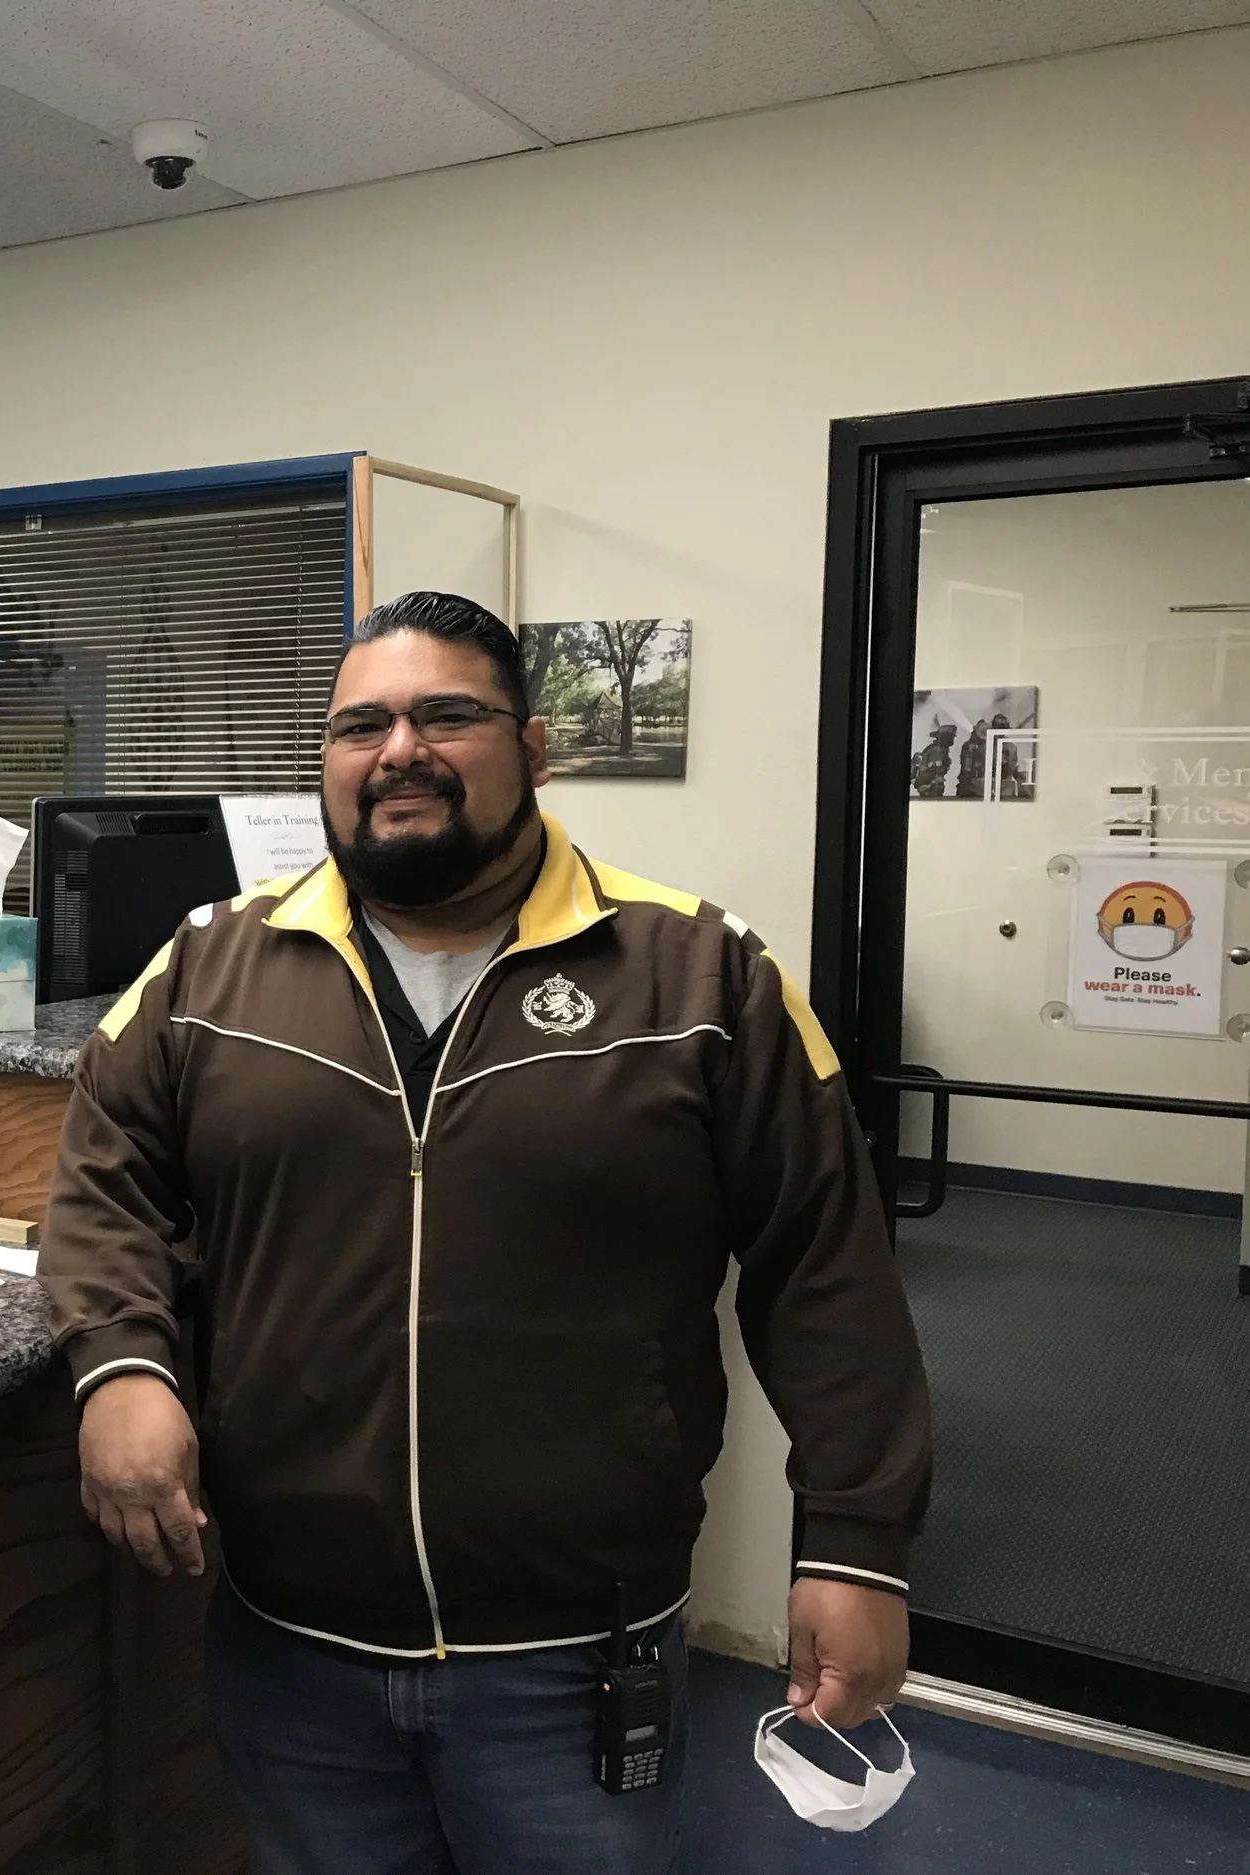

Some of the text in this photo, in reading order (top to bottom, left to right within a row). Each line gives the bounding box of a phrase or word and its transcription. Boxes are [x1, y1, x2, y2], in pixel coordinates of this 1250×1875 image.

[245, 814, 319, 827] Teller in Training
[270, 847, 281, 855] will
[281, 847, 288, 855] be
[289, 847, 306, 856] happy
[306, 847, 314, 855] to
[290, 863, 301, 871] you
[1114, 966, 1172, 982] Please
[1084, 981, 1202, 997] wear a mask.
